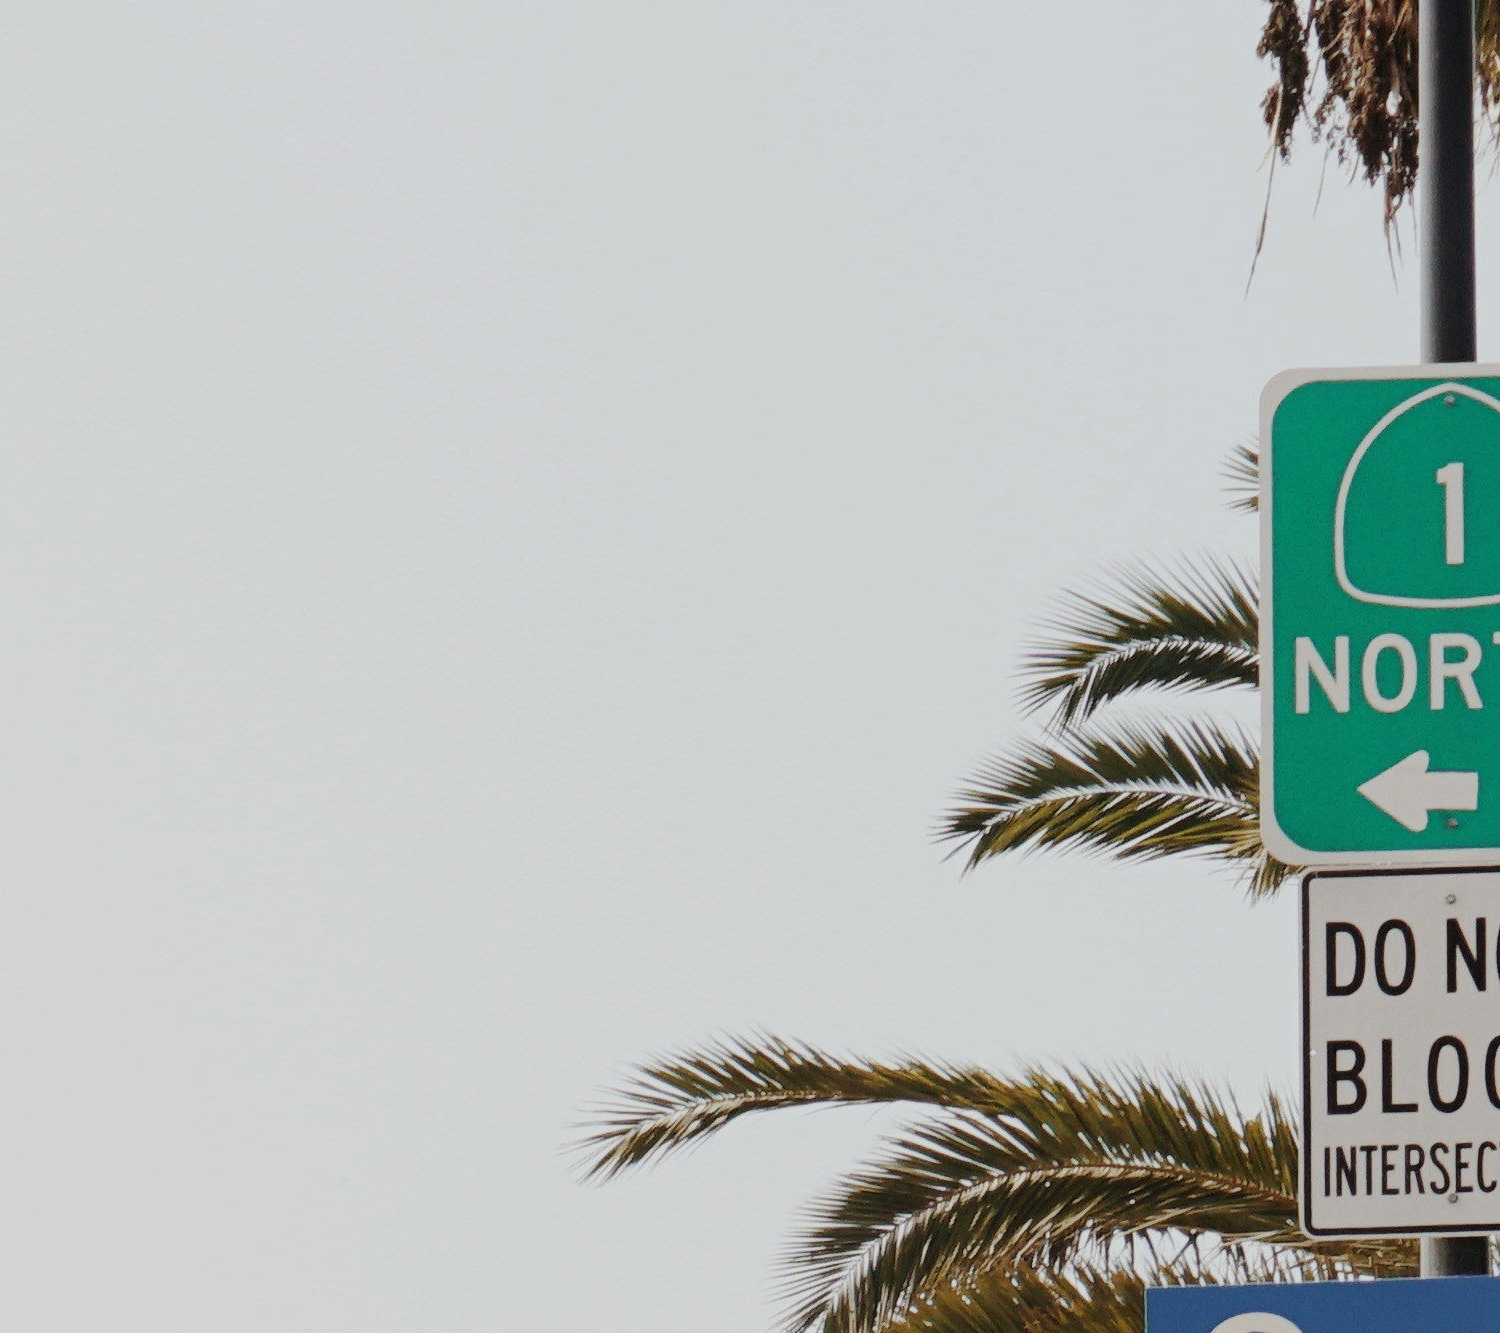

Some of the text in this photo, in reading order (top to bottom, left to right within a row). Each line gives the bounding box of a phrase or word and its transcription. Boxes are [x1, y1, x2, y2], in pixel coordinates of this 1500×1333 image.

[1434, 462, 1465, 566] 1
[1294, 631, 1500, 715] NOR
[1325, 917, 1500, 997] DO N
[1324, 1141, 1500, 1198] INTERSEC
